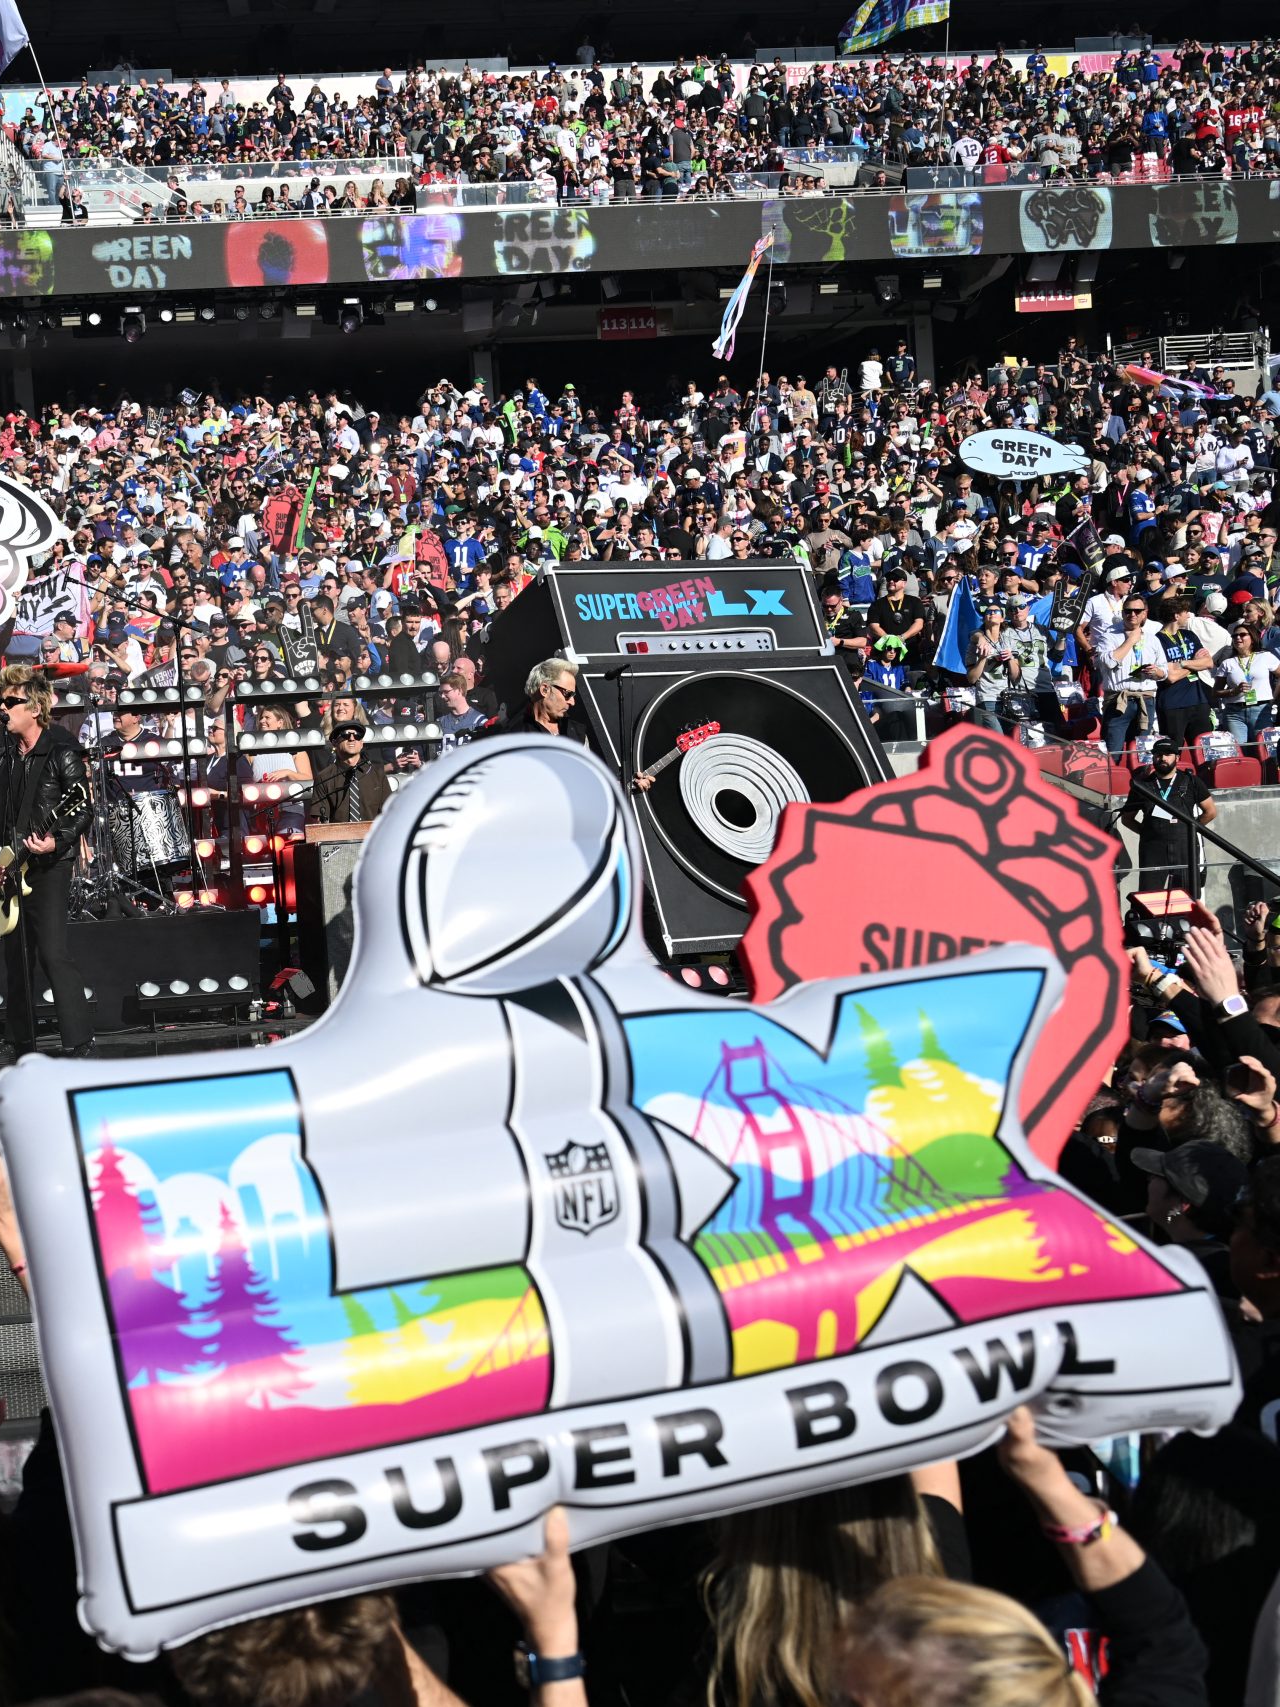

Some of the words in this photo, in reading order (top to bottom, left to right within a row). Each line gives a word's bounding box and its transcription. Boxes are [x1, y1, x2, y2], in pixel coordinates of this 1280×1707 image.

[505, 246, 572, 272] DAY
[106, 263, 168, 289] DAY
[1020, 290, 1046, 302] 114
[1048, 289, 1072, 301] 115
[602, 319, 626, 330] 113
[630, 318, 655, 329] 114
[990, 438, 1052, 459] GREEN
[1002, 451, 1039, 468] DAY
[575, 593, 644, 621] SUPER
[706, 589, 793, 617] LX
[637, 576, 717, 612] GREEN
[658, 602, 708, 632] DAY
[298, 666, 314, 676] DAY
[860, 923, 1010, 974] SUPE
[555, 1177, 615, 1225] NFL
[286, 1406, 729, 1553] SUPER
[786, 1321, 1118, 1451] BOWL
